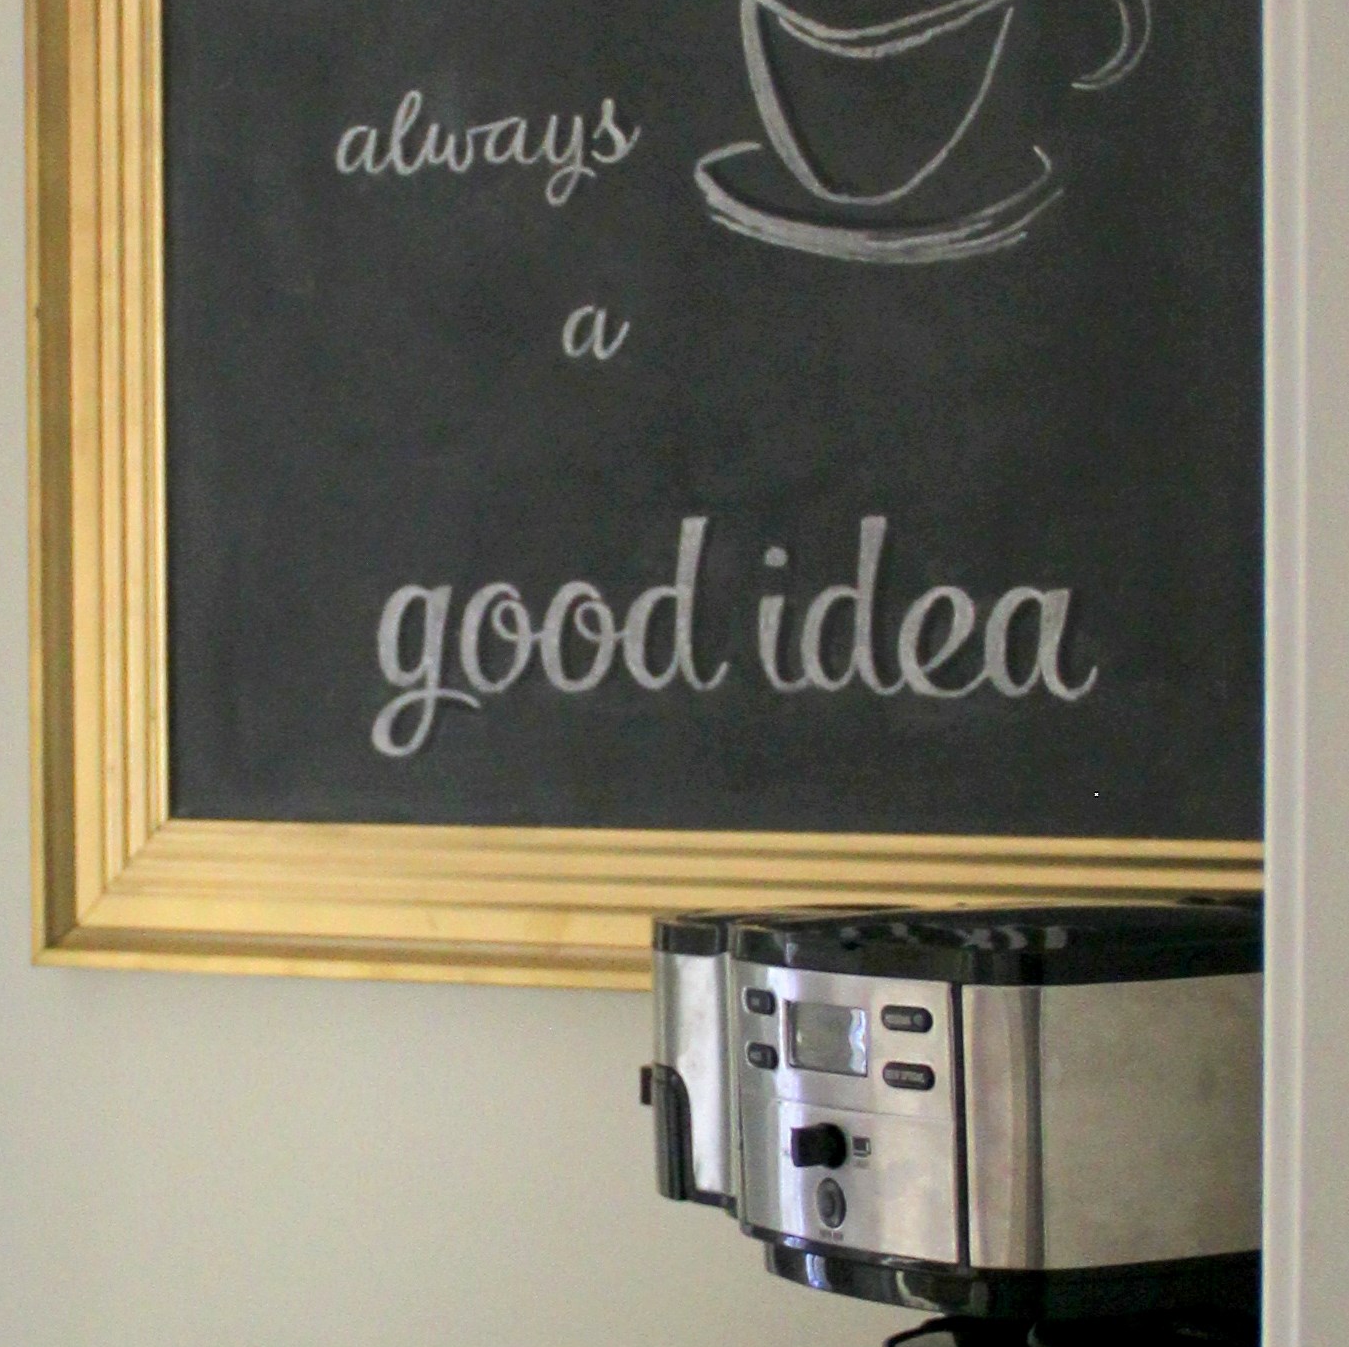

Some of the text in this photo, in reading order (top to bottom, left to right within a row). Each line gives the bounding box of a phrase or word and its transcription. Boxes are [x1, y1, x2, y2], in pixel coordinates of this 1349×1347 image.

[334, 88, 641, 207] always
[561, 304, 631, 361] a
[370, 514, 1099, 759] good idea
